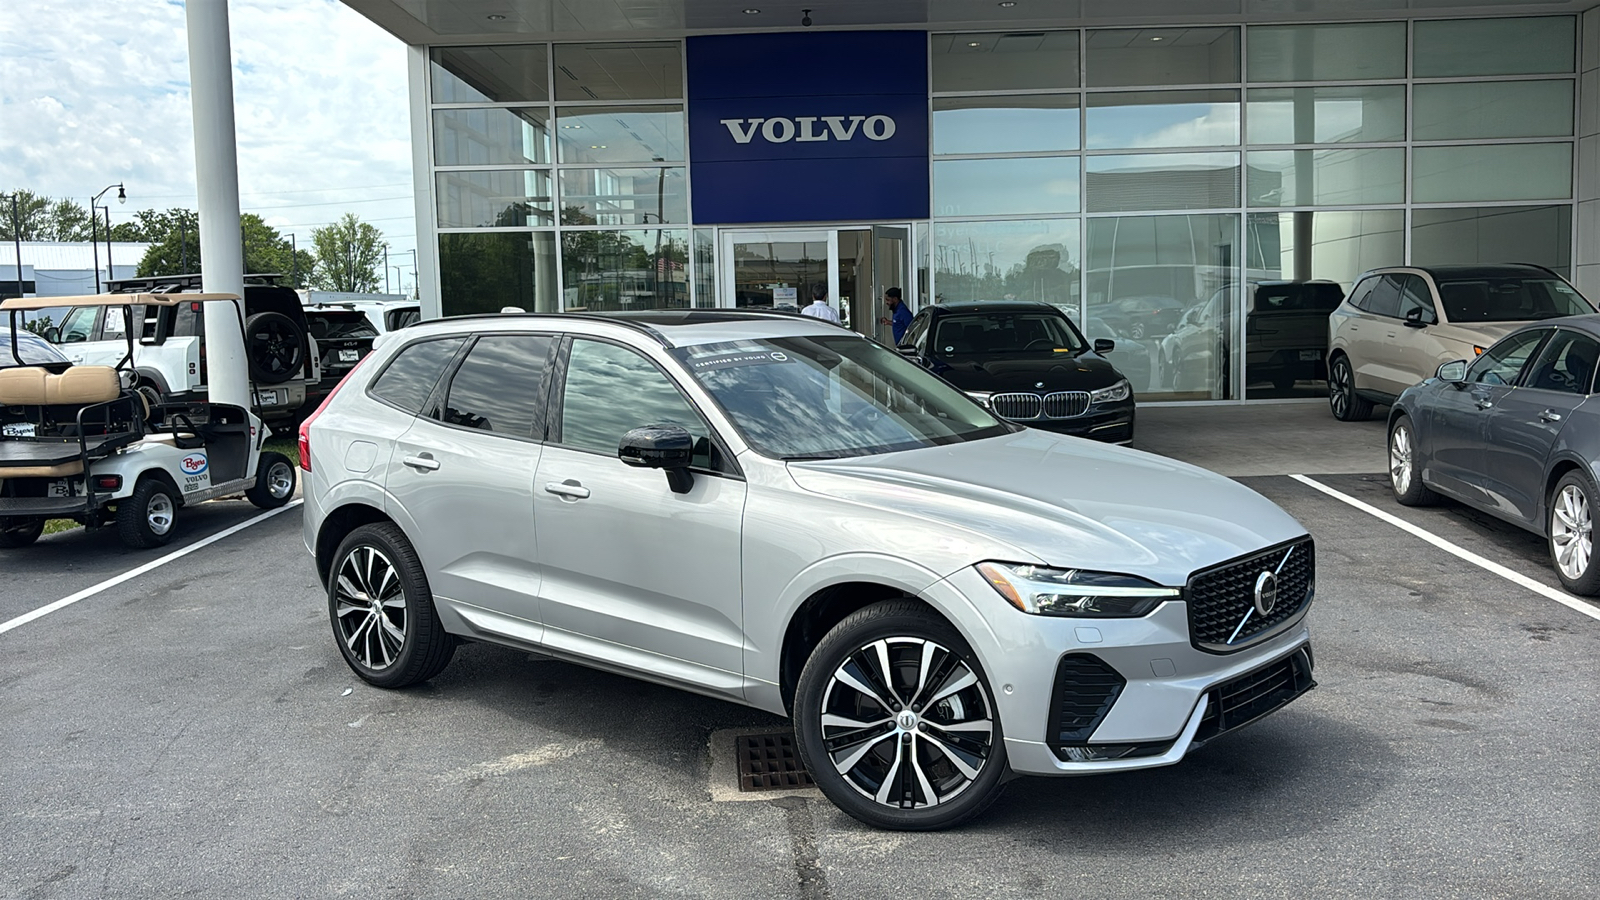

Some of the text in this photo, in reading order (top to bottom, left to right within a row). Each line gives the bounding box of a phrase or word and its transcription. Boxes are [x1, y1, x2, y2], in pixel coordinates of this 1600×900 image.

[720, 114, 896, 143] VOLVO
[695, 358, 732, 367] CERTIFIED
[183, 457, 206, 471] Byers
[185, 474, 208, 483] VOLVO
